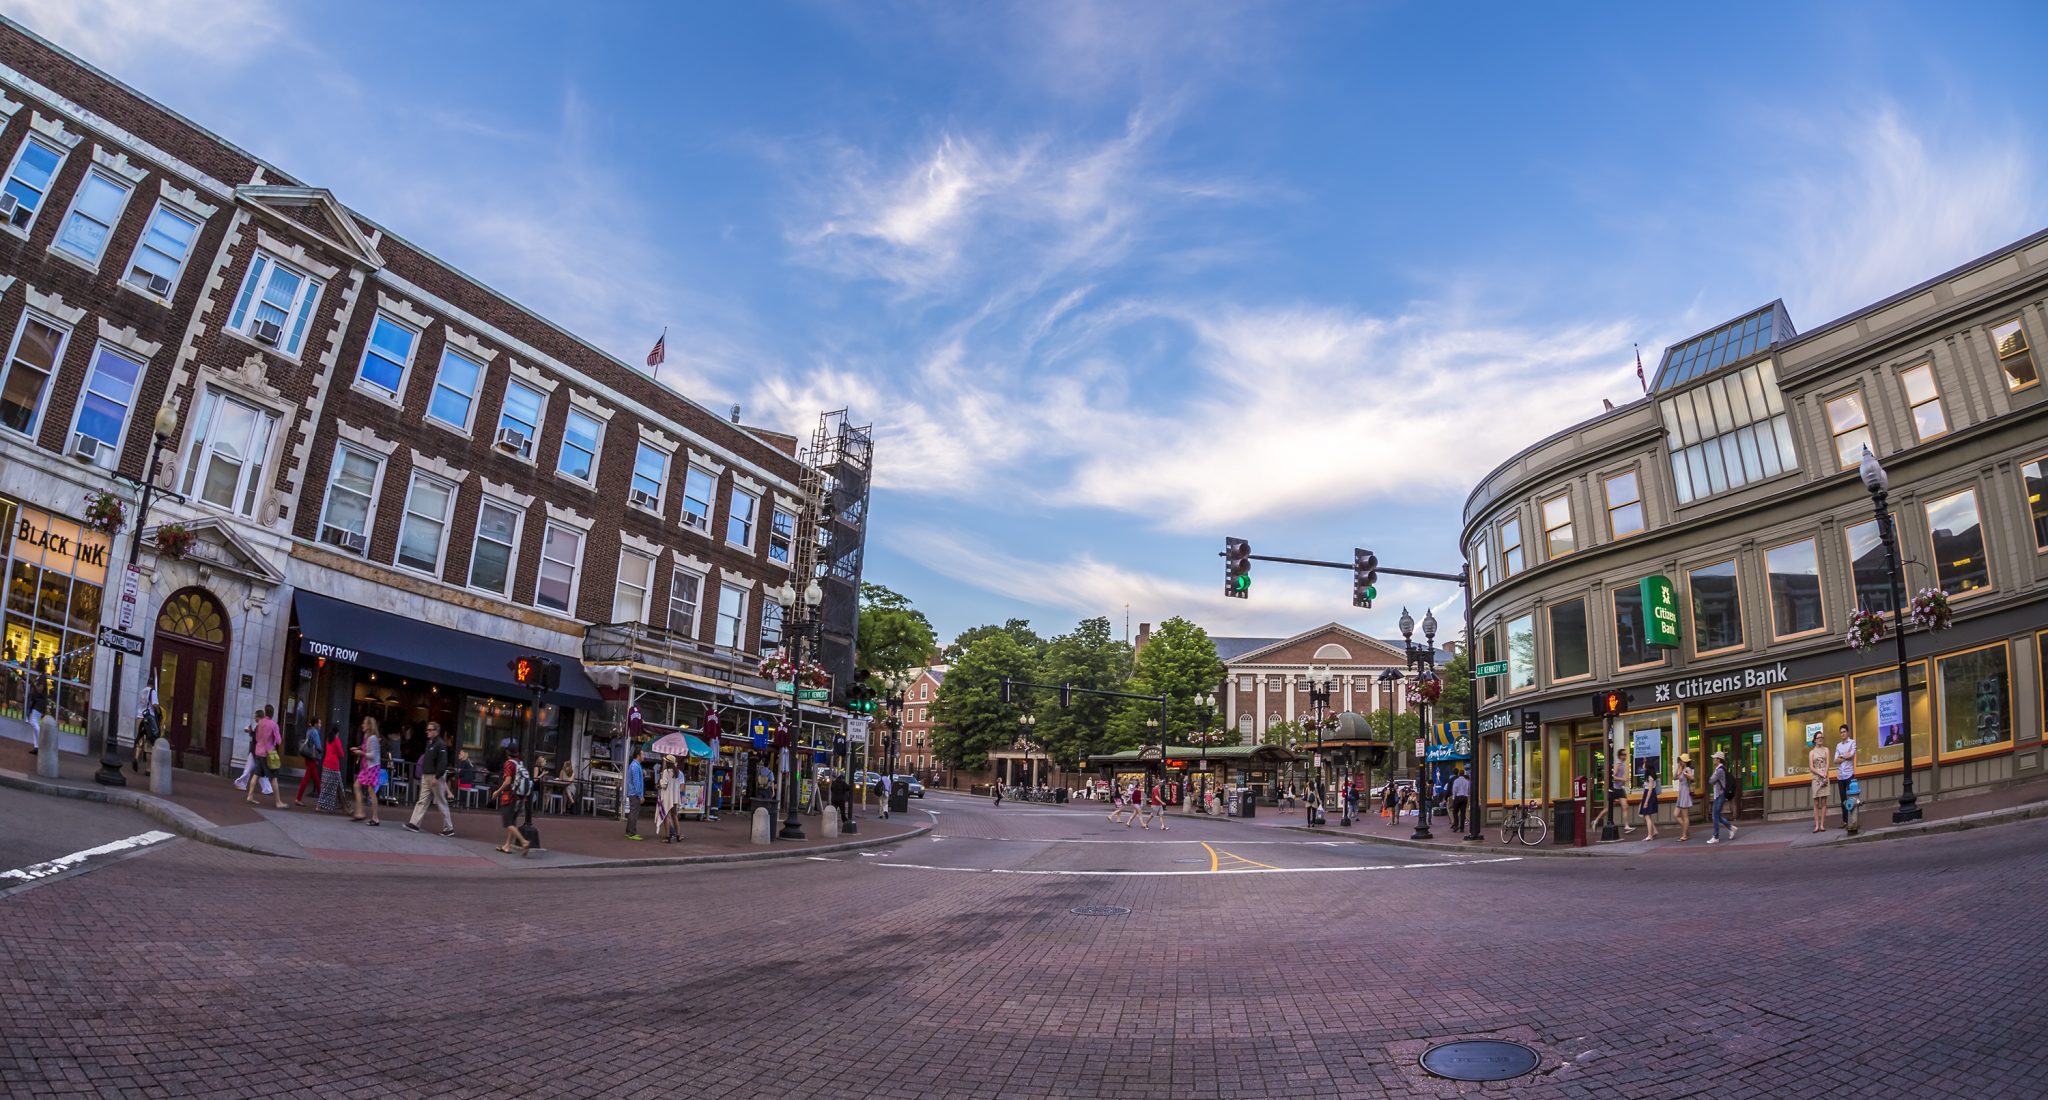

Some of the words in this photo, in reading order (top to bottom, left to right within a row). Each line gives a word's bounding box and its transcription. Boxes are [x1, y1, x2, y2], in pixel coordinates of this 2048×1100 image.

[19, 518, 69, 555] BLACK
[76, 542, 106, 567] INK
[1655, 606, 1677, 622] Citizens
[1661, 621, 1676, 635] Bank
[112, 635, 124, 646] ONE
[309, 641, 335, 657] TORY
[335, 647, 359, 662] ROW
[1484, 664, 1501, 674] KENNEDY
[1675, 677, 1742, 699] Citizens
[1744, 662, 1788, 688] Bank
[1477, 719, 1494, 734] itizens
[1493, 710, 1512, 729] Bank
